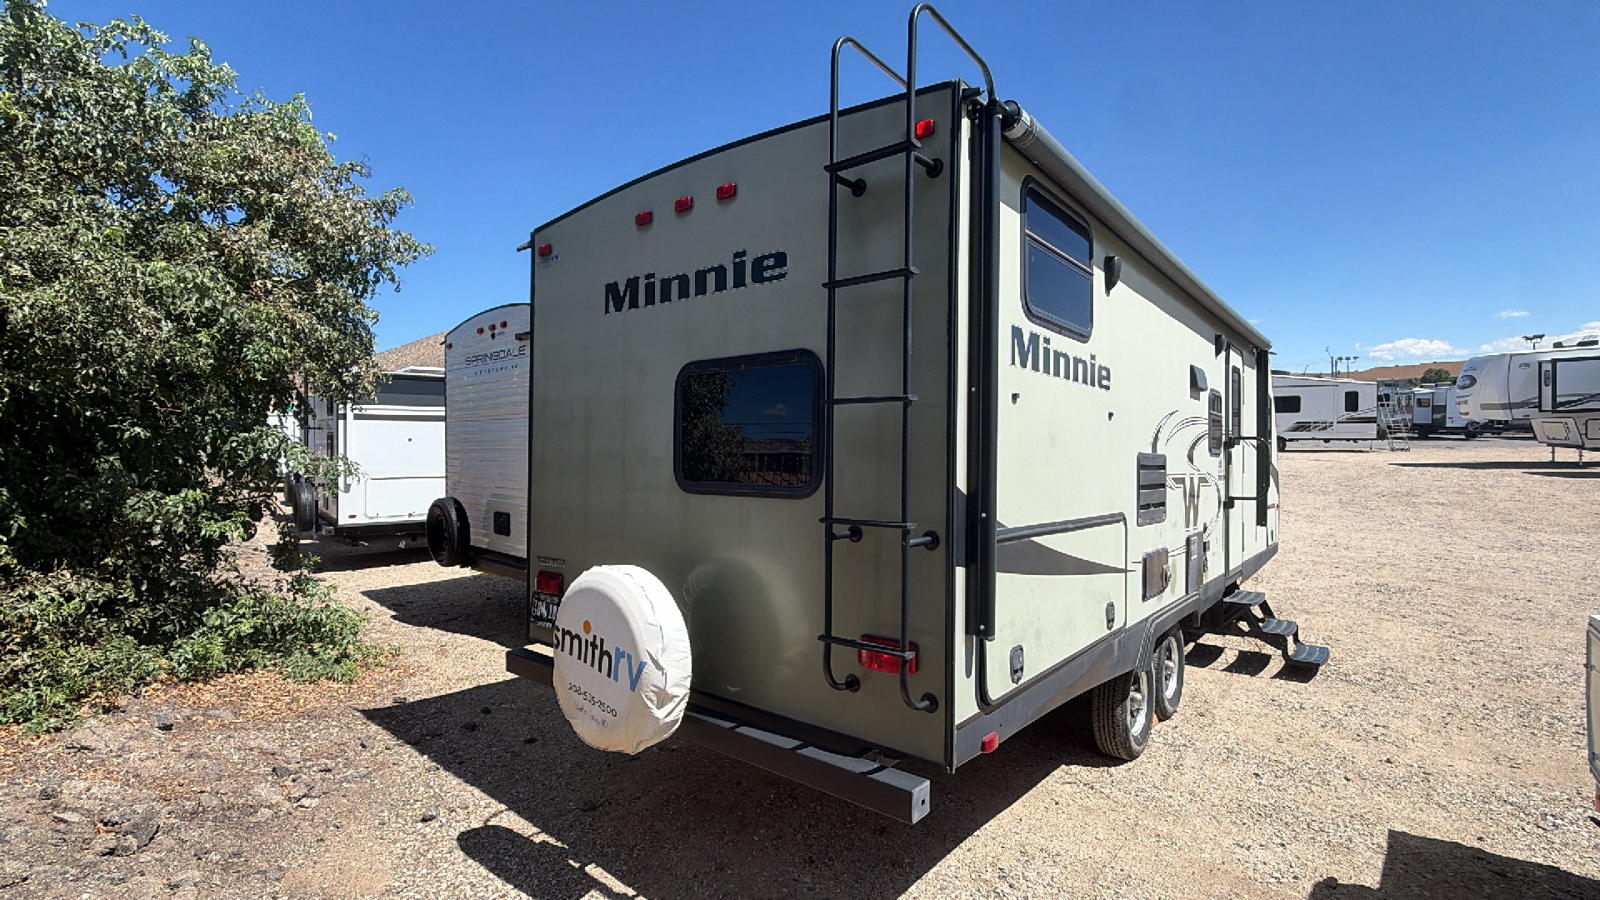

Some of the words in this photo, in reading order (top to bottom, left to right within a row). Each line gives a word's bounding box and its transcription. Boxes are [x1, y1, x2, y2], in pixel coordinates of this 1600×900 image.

[604, 249, 789, 315] Minnie
[465, 345, 526, 365] SPRINGDALE
[1010, 323, 1112, 391] Minnie
